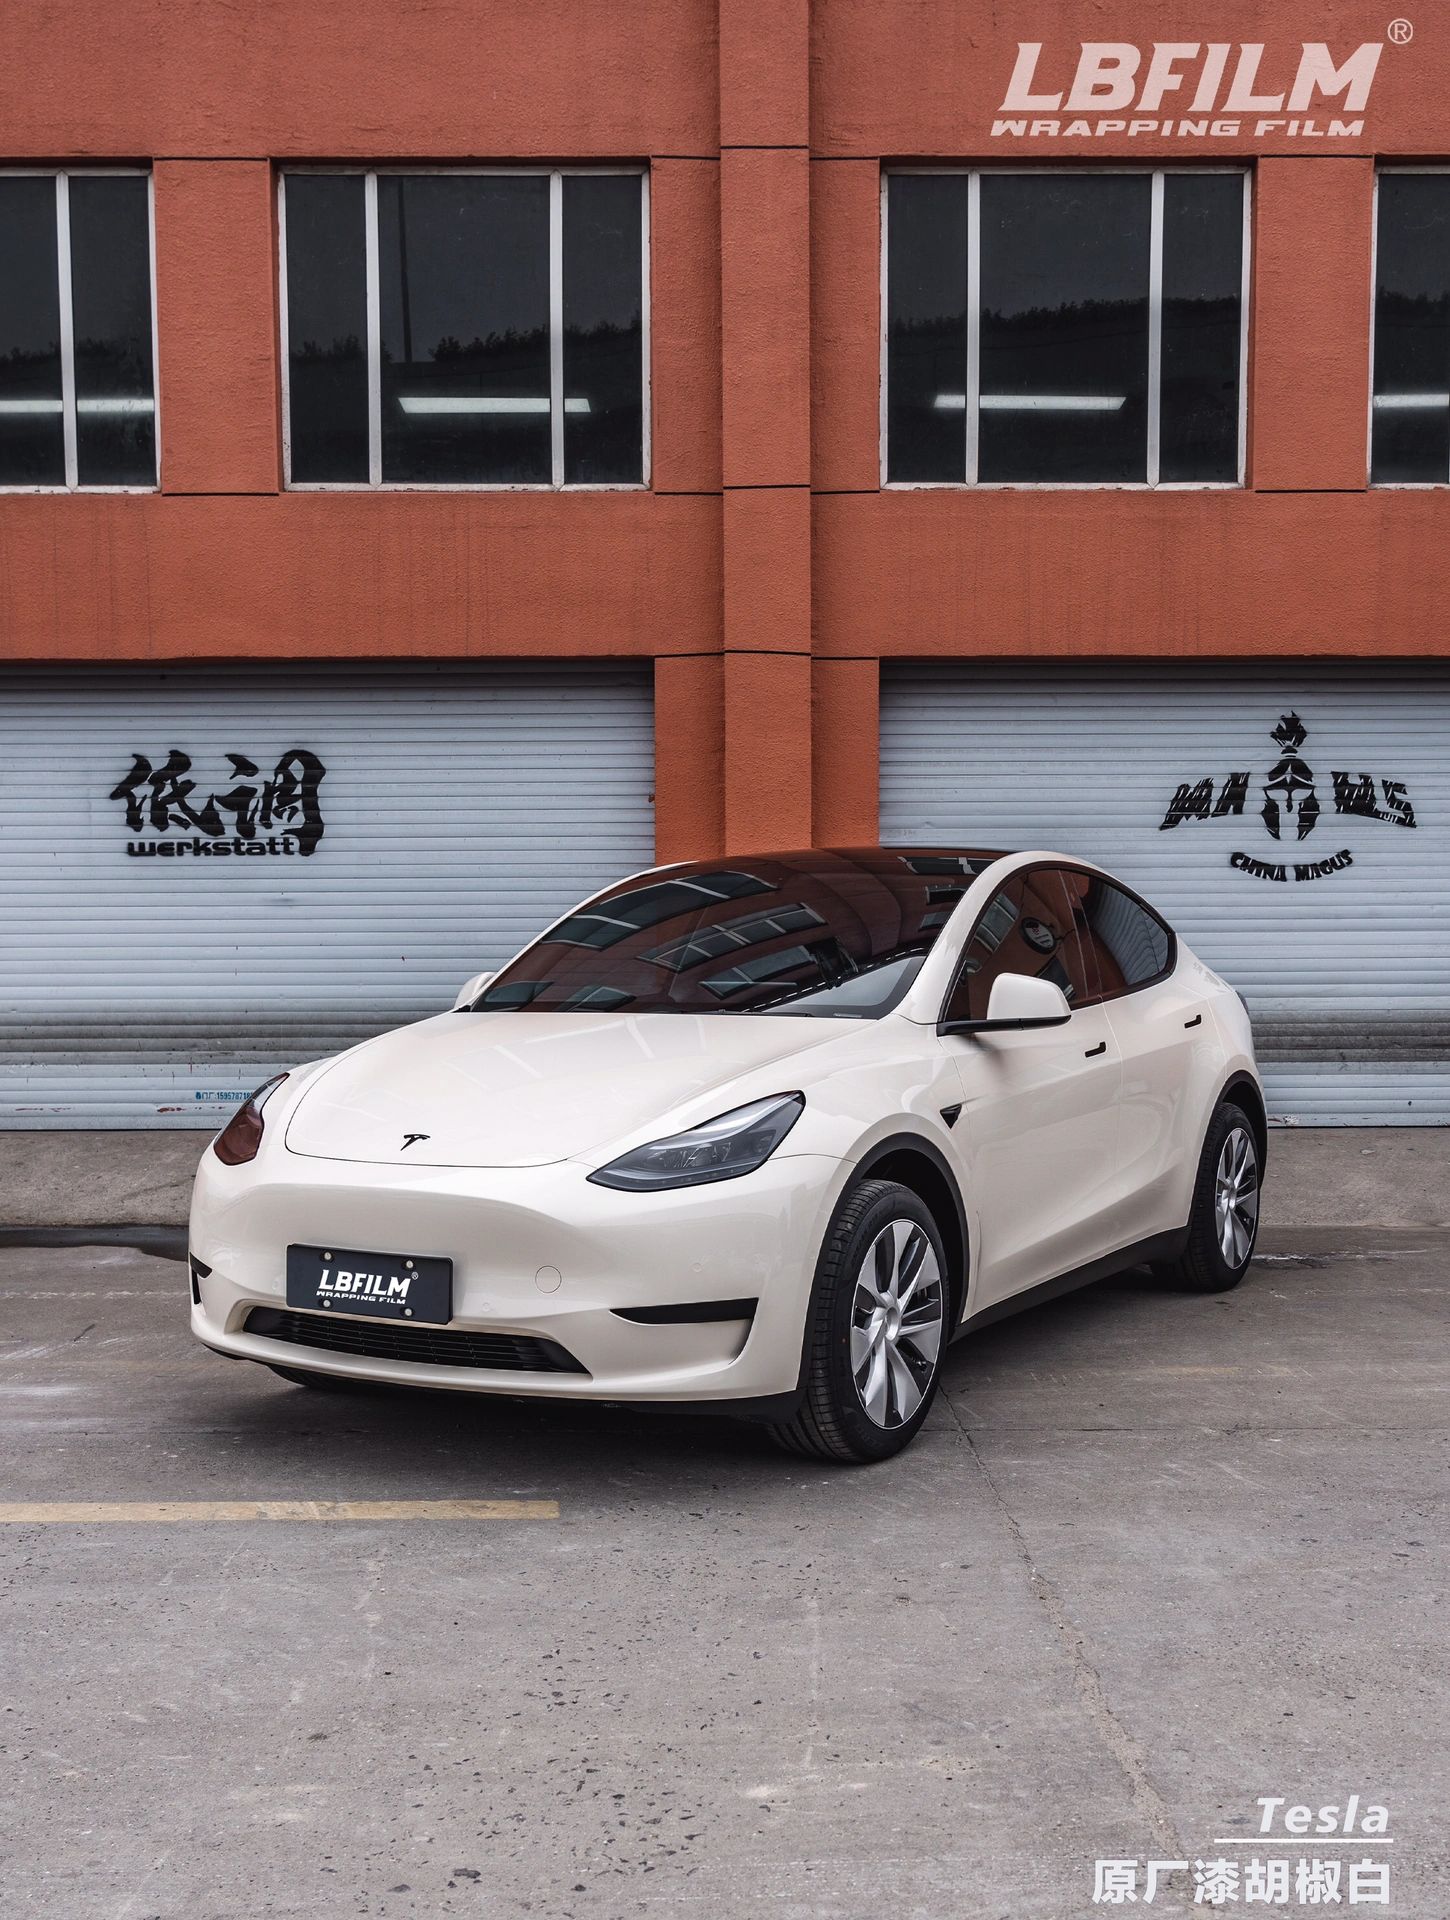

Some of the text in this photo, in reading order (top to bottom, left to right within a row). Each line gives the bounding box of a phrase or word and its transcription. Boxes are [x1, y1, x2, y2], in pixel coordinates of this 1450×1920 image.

[127, 837, 295, 857] werkstatt
[1230, 848, 1353, 882] CHINA MAGUS
[318, 1269, 411, 1298] LBFILM
[316, 1290, 406, 1305] WRAPPING FILM
